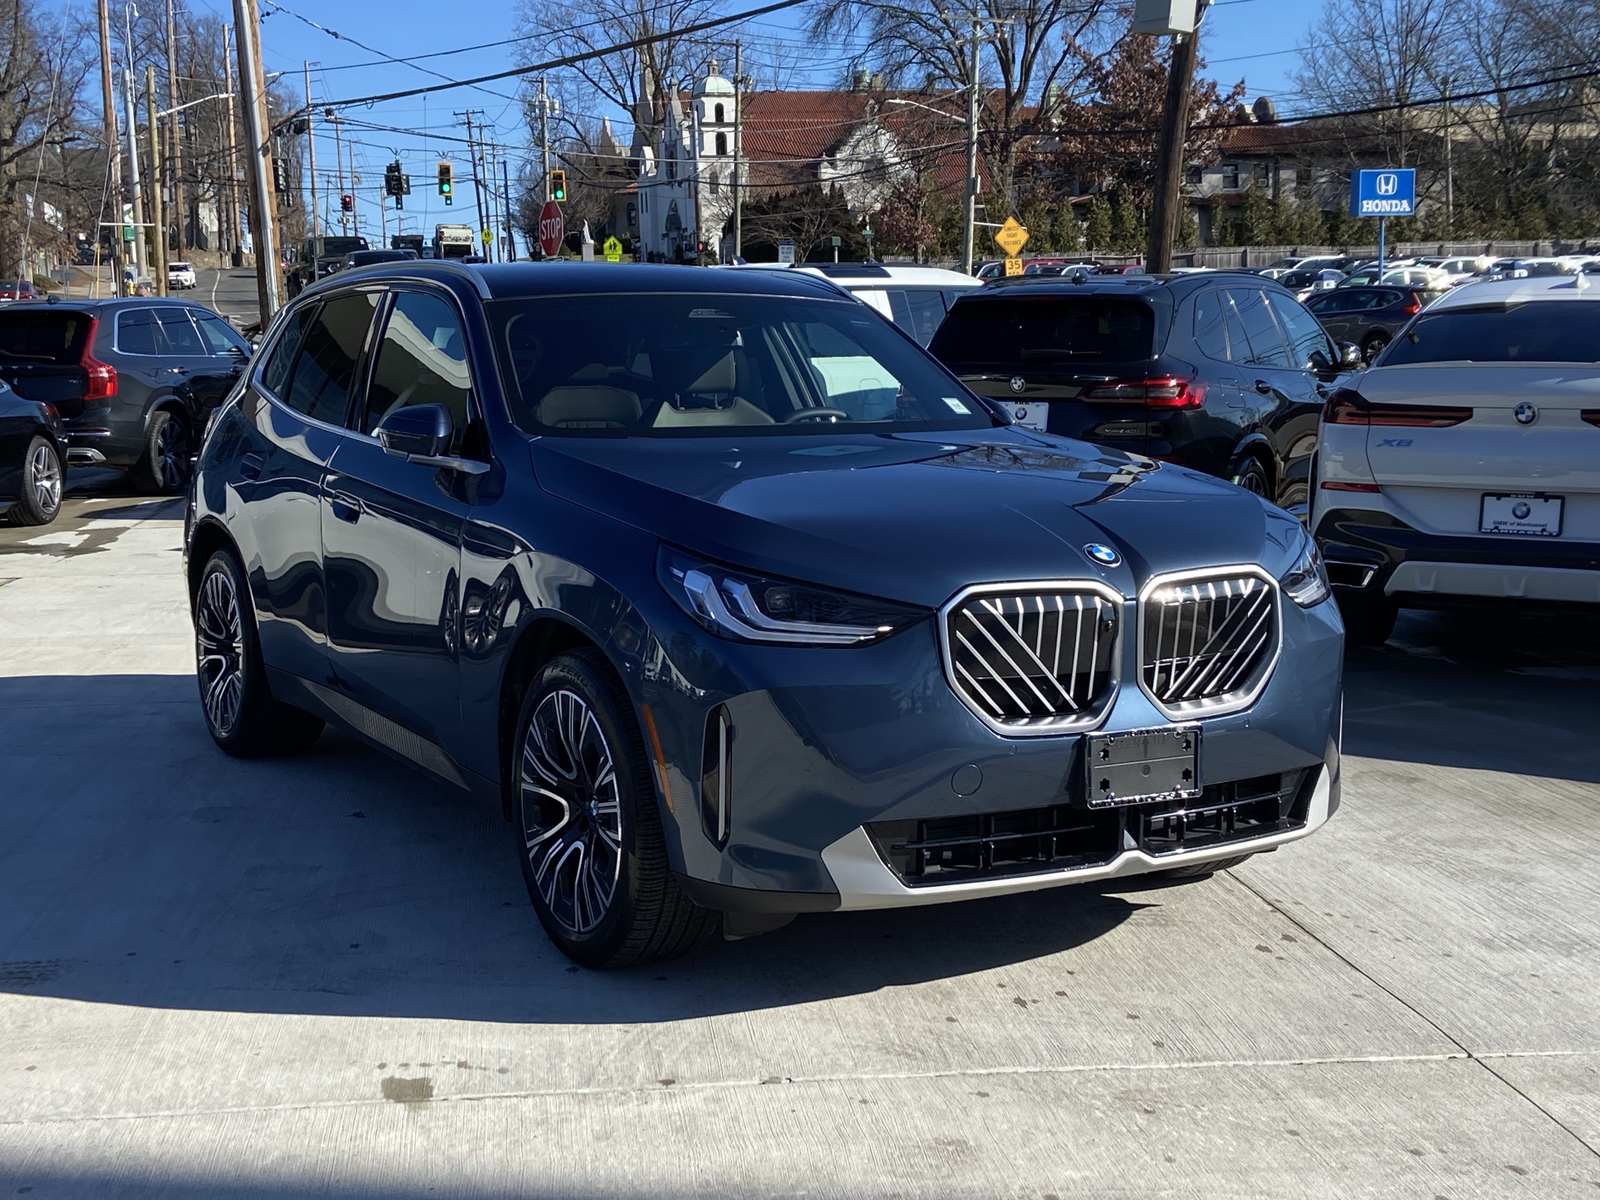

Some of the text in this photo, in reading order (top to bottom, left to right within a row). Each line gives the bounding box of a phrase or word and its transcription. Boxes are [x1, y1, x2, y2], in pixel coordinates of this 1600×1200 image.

[1362, 199, 1411, 213] HONDA
[541, 217, 561, 241] STOP
[1008, 260, 1021, 270] 35
